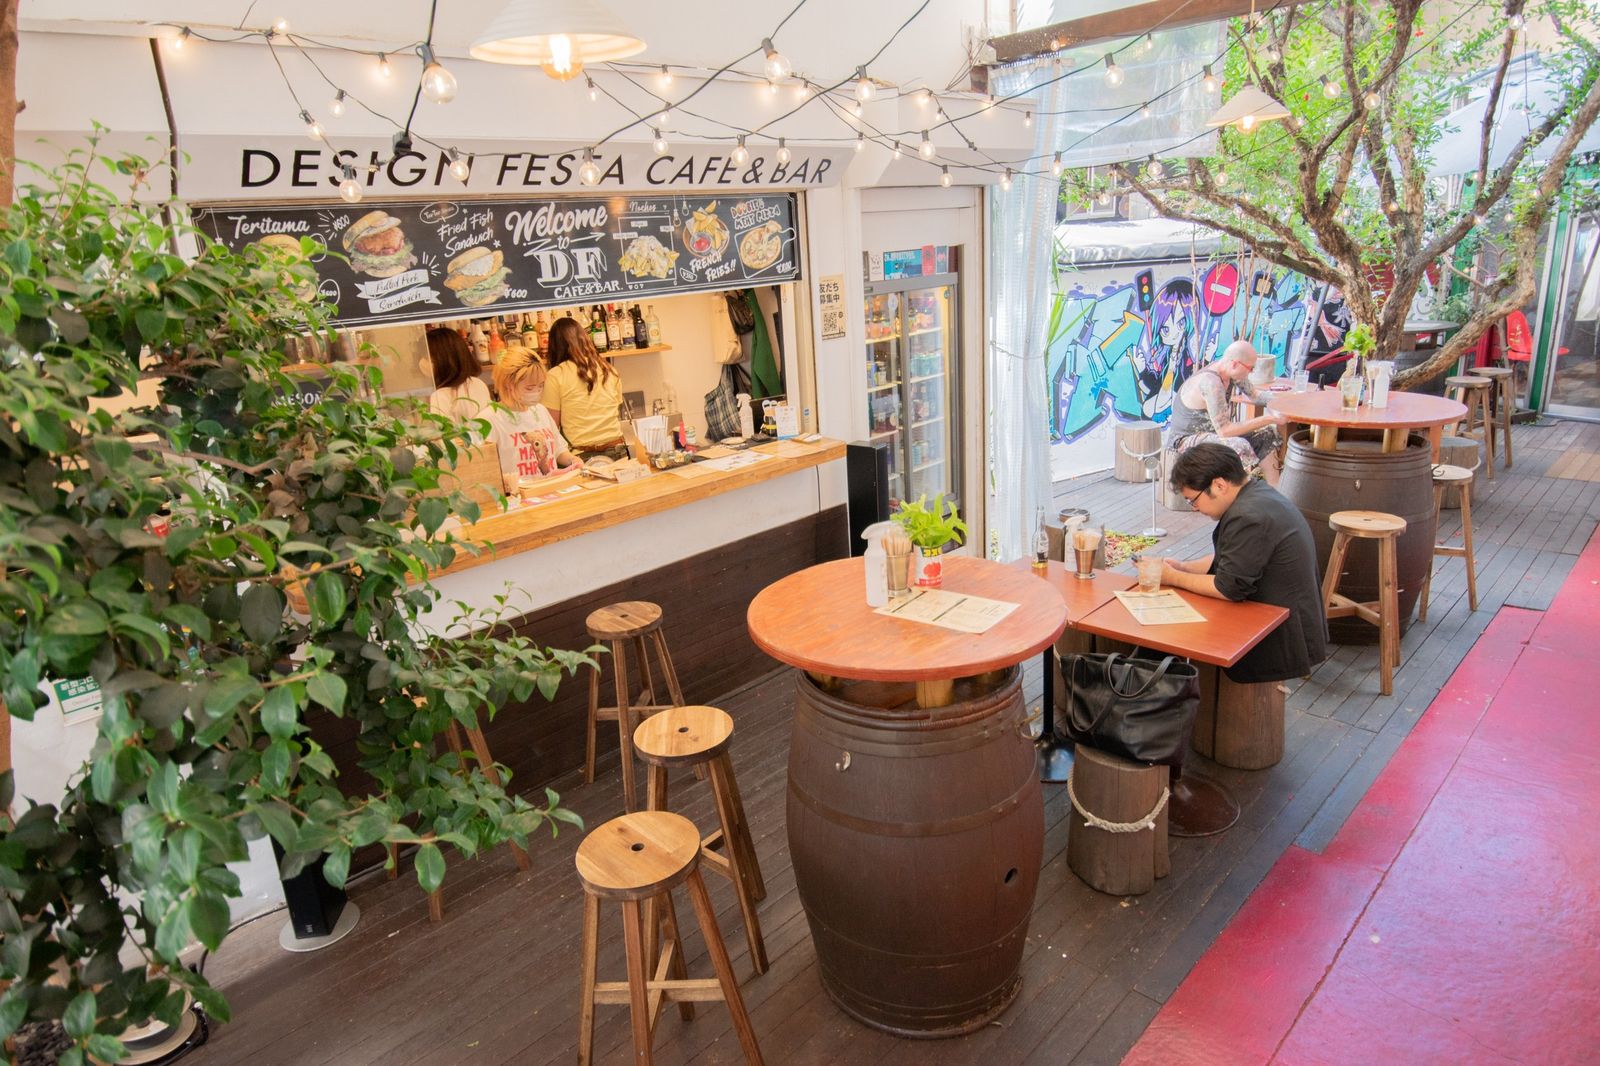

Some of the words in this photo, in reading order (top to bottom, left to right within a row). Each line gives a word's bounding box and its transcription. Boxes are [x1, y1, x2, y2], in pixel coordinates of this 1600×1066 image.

[241, 149, 475, 188] DESIGN
[437, 217, 467, 242] Fried
[469, 208, 494, 230] Fish
[505, 201, 608, 246] Welcome
[755, 204, 781, 223] PIZZA
[227, 215, 310, 239] Teritama
[444, 227, 494, 258] Sandwich
[557, 235, 570, 250] to
[689, 249, 722, 273] FRENCH
[705, 259, 737, 282] FRIES!!
[503, 288, 528, 299] ¥600
